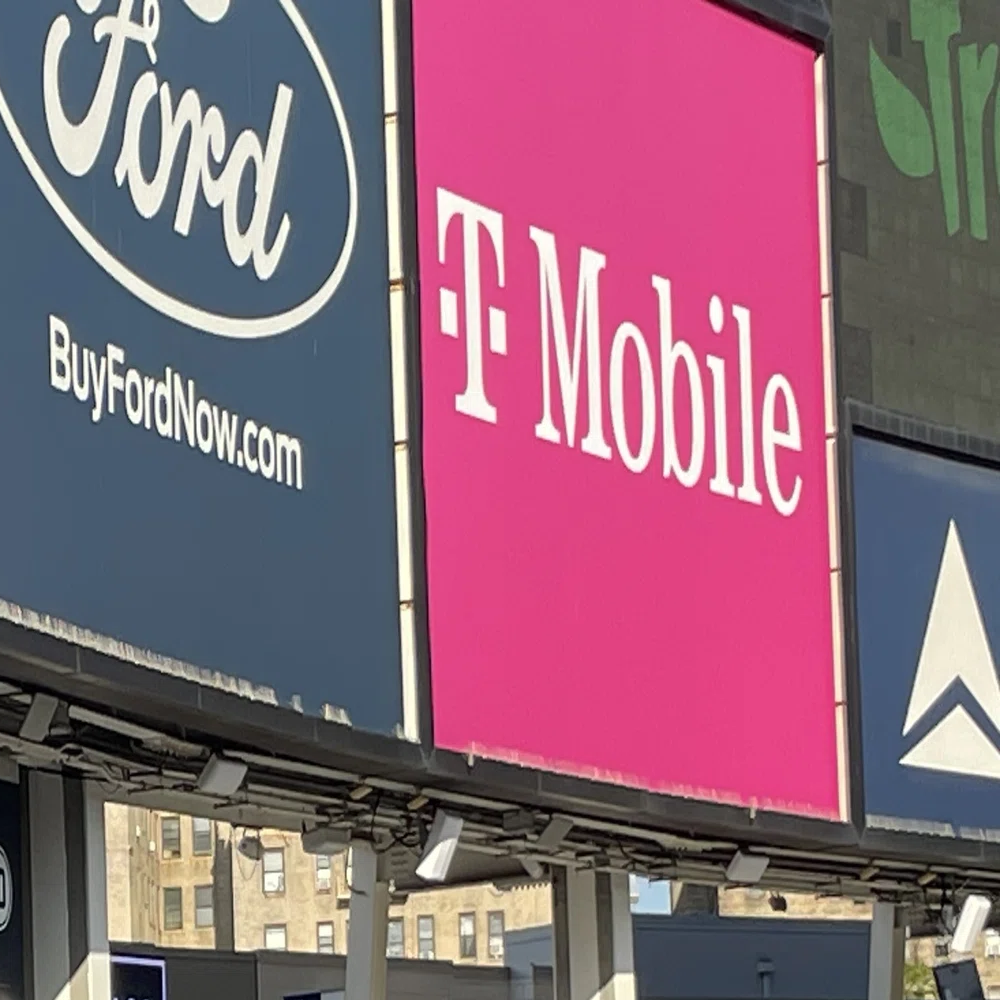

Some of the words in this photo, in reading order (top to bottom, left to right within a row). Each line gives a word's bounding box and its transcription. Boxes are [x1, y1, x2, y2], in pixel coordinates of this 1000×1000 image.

[43, 0, 293, 280] Ford
[49, 314, 304, 490] BuyFordNow.com
[530, 225, 802, 516] Mobile
